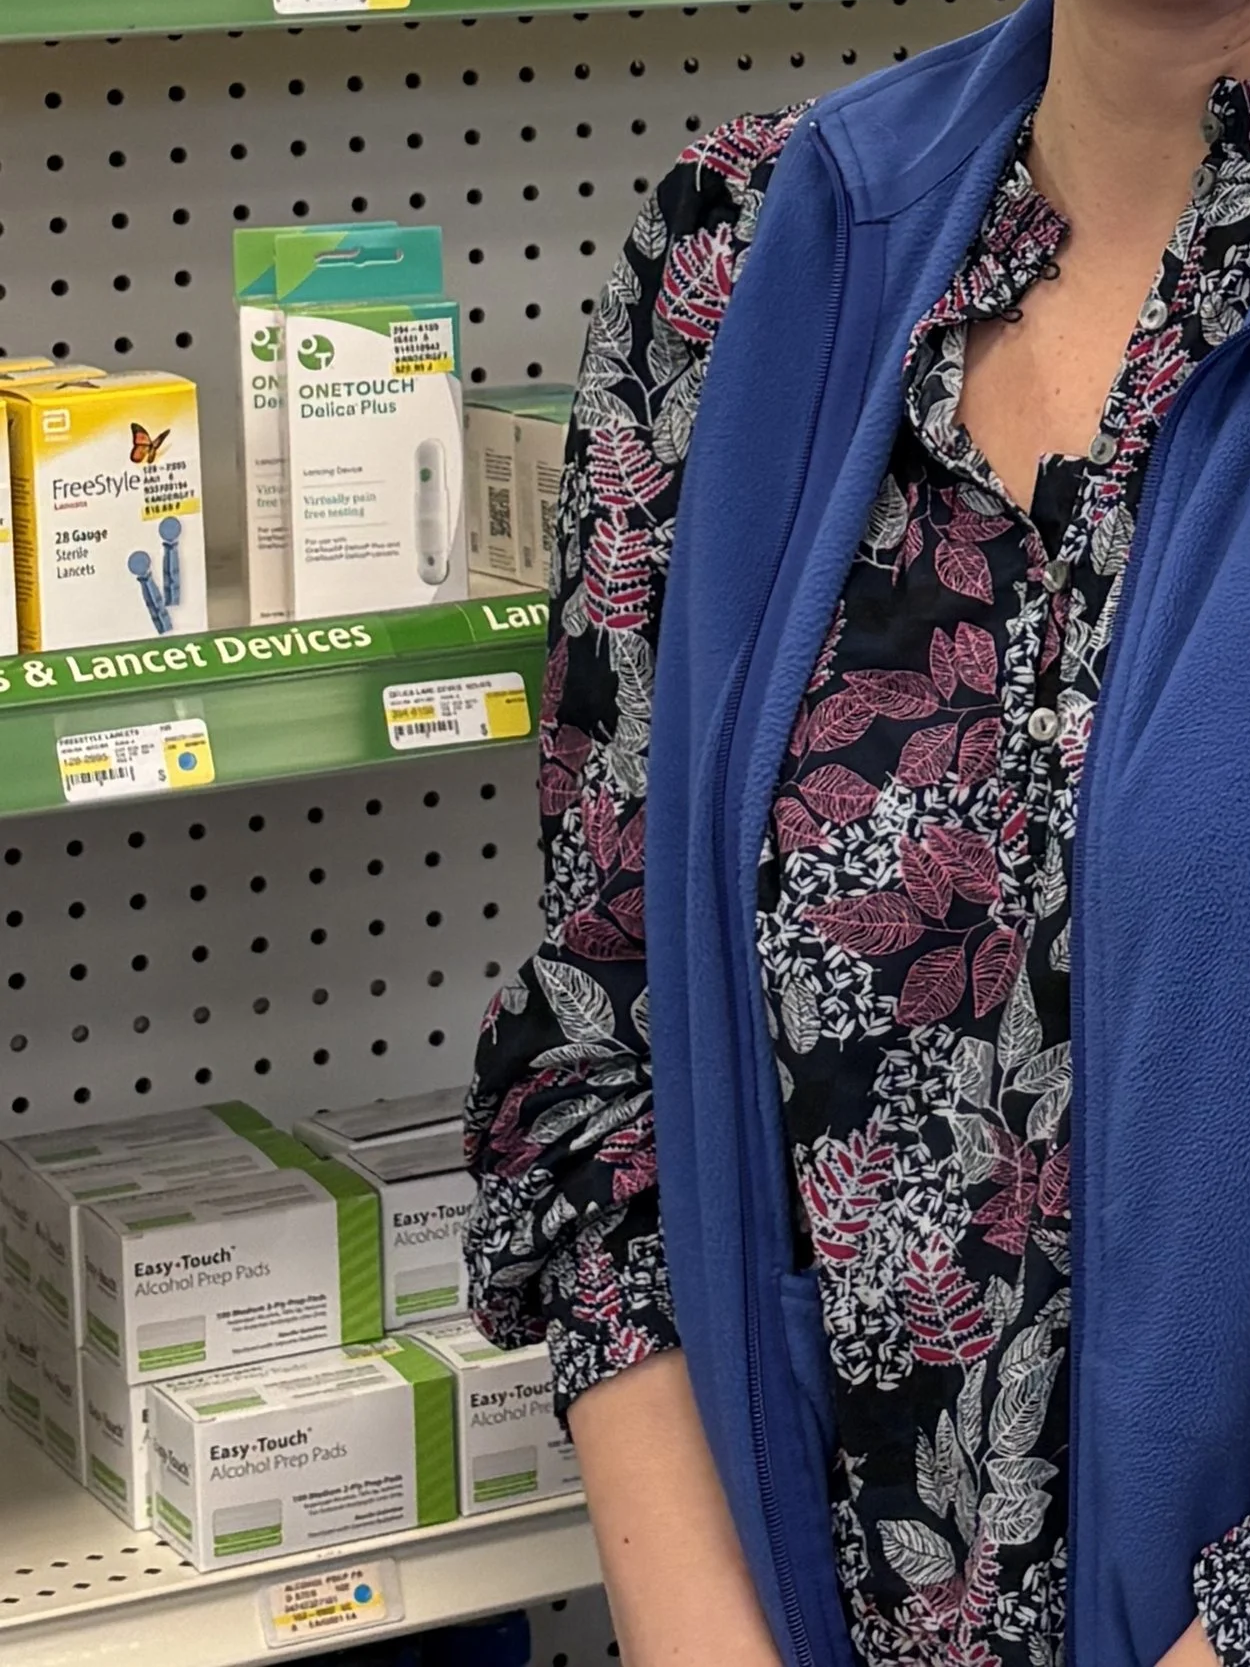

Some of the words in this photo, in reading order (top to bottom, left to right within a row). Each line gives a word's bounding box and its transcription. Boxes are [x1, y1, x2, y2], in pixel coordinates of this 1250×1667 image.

[300, 379, 415, 400] ONETOUCH
[301, 403, 356, 419] Delica
[360, 399, 397, 415] Plus
[52, 471, 141, 500] FreeStyle
[303, 494, 349, 507] Virtually
[352, 492, 377, 505] pain
[303, 508, 326, 520] free
[55, 531, 70, 545] 28
[72, 528, 108, 545] Gauge
[56, 548, 89, 563] Sterile
[57, 563, 96, 580] Lancets
[23, 660, 58, 688] &
[67, 642, 207, 683] Lancet
[213, 620, 372, 666] Devices
[135, 1273, 194, 1297] Alcohol
[198, 1269, 232, 1286] Prep
[236, 1262, 271, 1280] Pads
[471, 1403, 528, 1428] Alcohol
[210, 1457, 271, 1481] Alcohol
[274, 1453, 309, 1471] Prep
[312, 1442, 348, 1463] Pads
